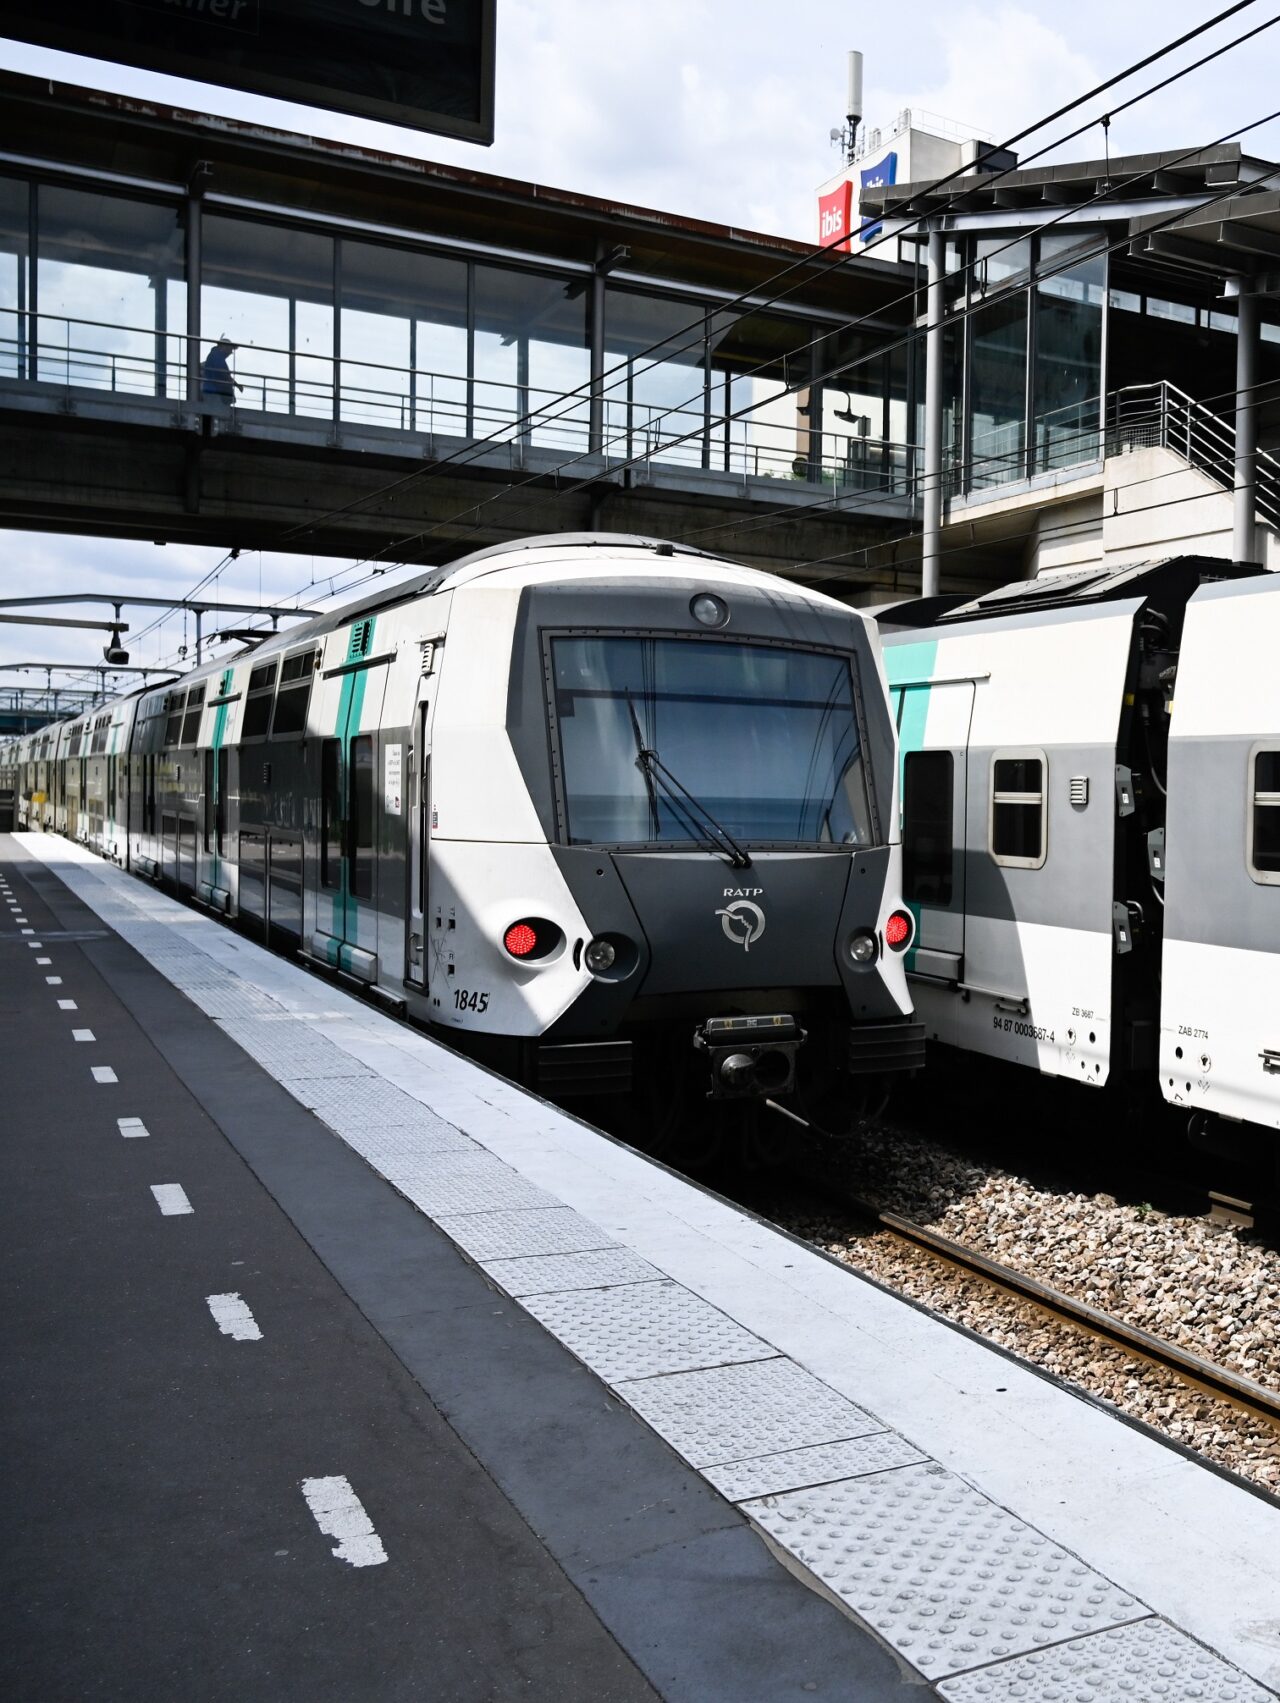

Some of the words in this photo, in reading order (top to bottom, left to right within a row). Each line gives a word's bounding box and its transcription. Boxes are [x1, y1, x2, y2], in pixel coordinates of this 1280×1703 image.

[822, 206, 843, 239] ibis
[723, 887, 764, 897] RATP
[454, 988, 488, 1013] 1845
[1081, 1008, 1095, 1020] 3687
[993, 1016, 1003, 1029] 94
[1003, 1018, 1013, 1032] 87
[1014, 1021, 1055, 1043] 0003687-4
[1178, 1024, 1193, 1037] ZAB
[1193, 1027, 1209, 1040] 2774
